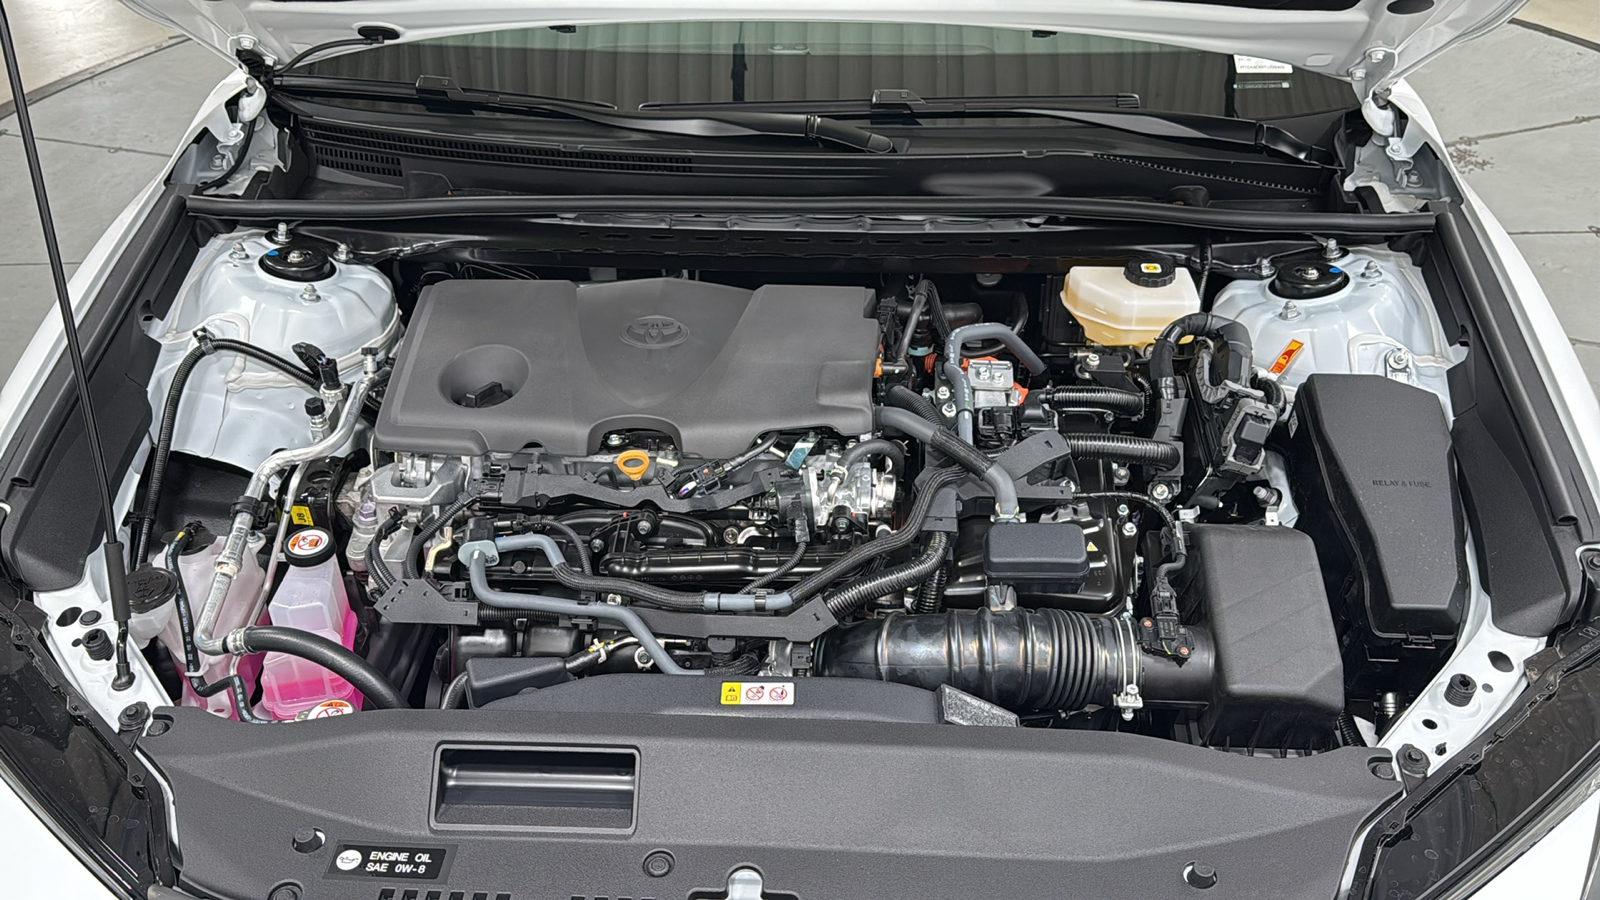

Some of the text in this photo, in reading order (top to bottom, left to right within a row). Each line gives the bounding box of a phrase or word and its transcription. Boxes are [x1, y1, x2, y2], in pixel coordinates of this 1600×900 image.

[1408, 480, 1431, 488] FUSE
[369, 851, 432, 863] ENGINE OIL
[365, 862, 427, 874] SAE 0W-8
